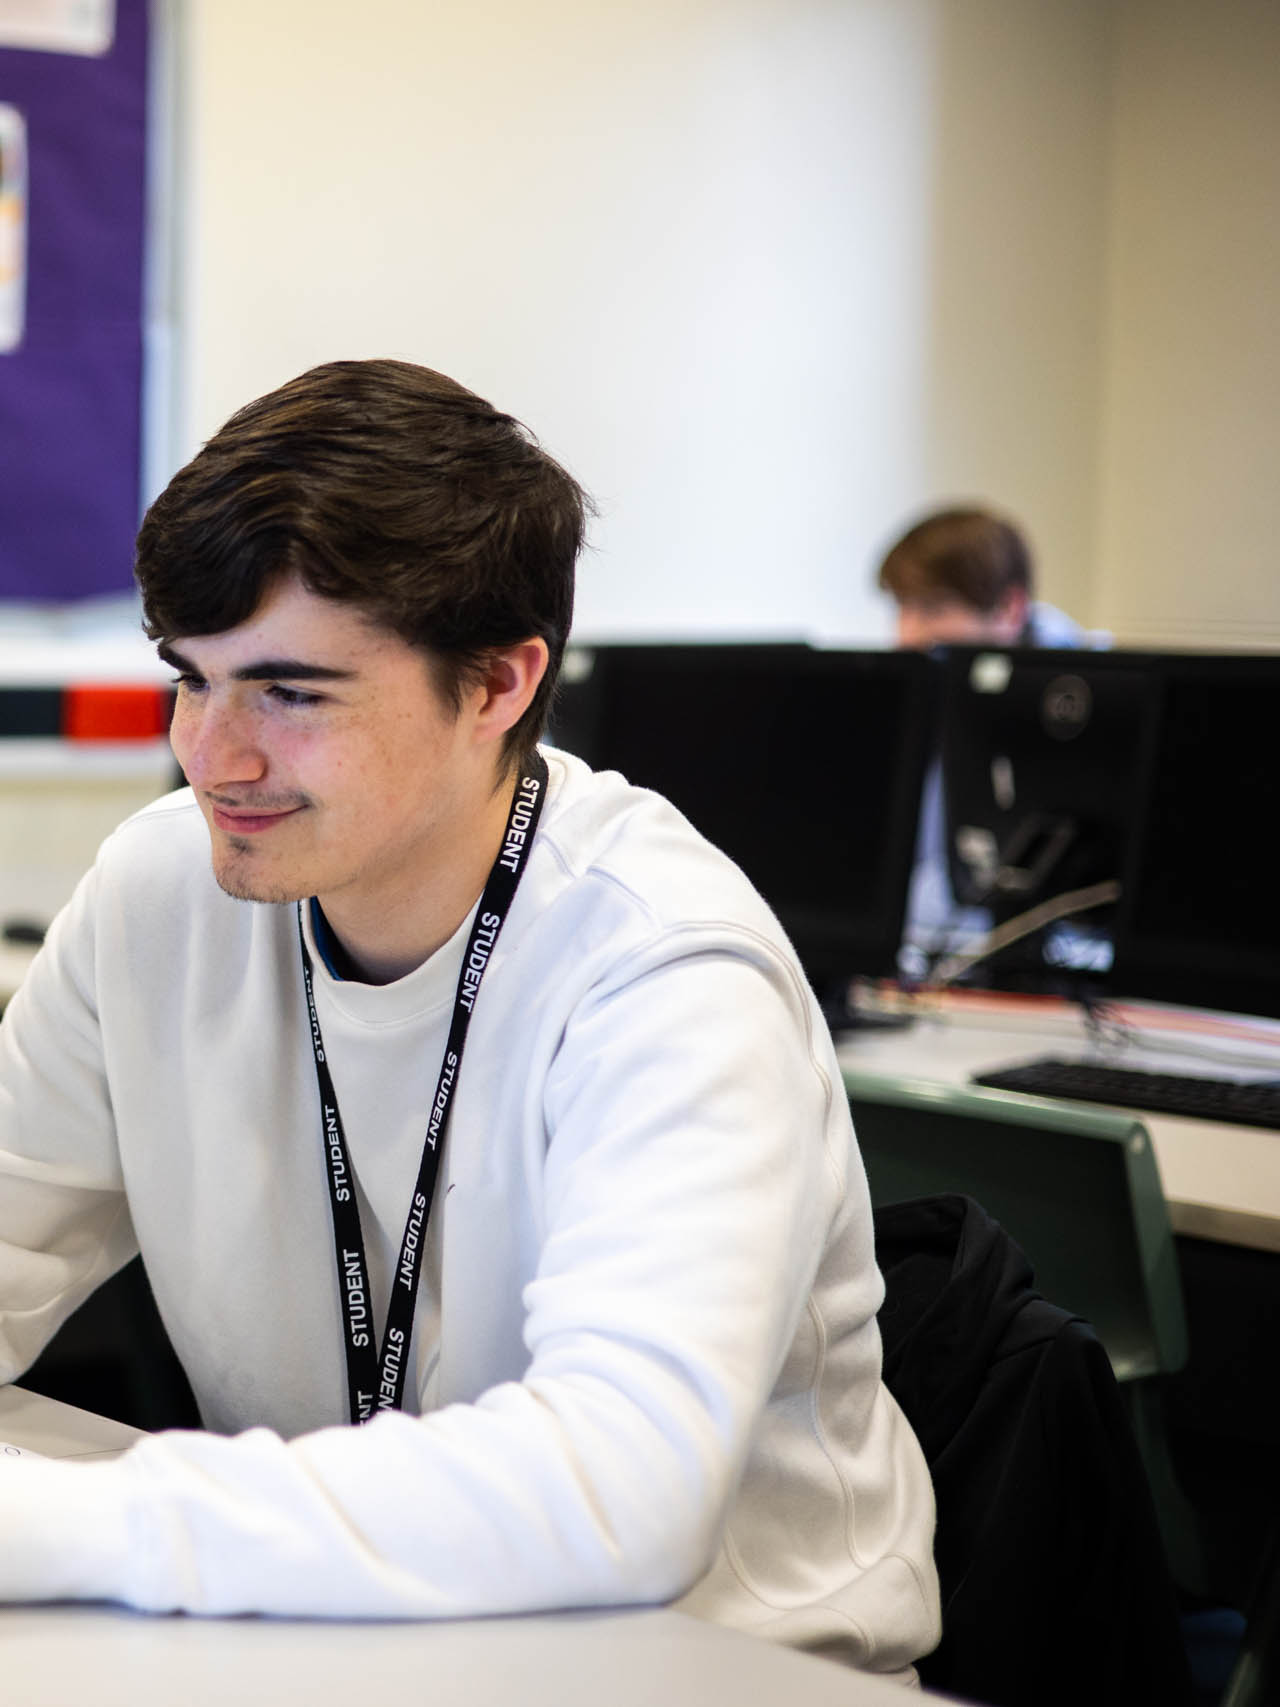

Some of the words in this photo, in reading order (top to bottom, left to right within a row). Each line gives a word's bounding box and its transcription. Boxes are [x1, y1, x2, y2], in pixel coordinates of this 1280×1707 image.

[497, 775, 540, 873] STUDENT
[458, 911, 501, 1013] STUDENT
[425, 1051, 458, 1152] STUDENT
[324, 1104, 350, 1202] STUDENT
[398, 1191, 427, 1292] STUDENT
[342, 1248, 369, 1348] STUDENT
[377, 1327, 405, 1411] STUDEN
